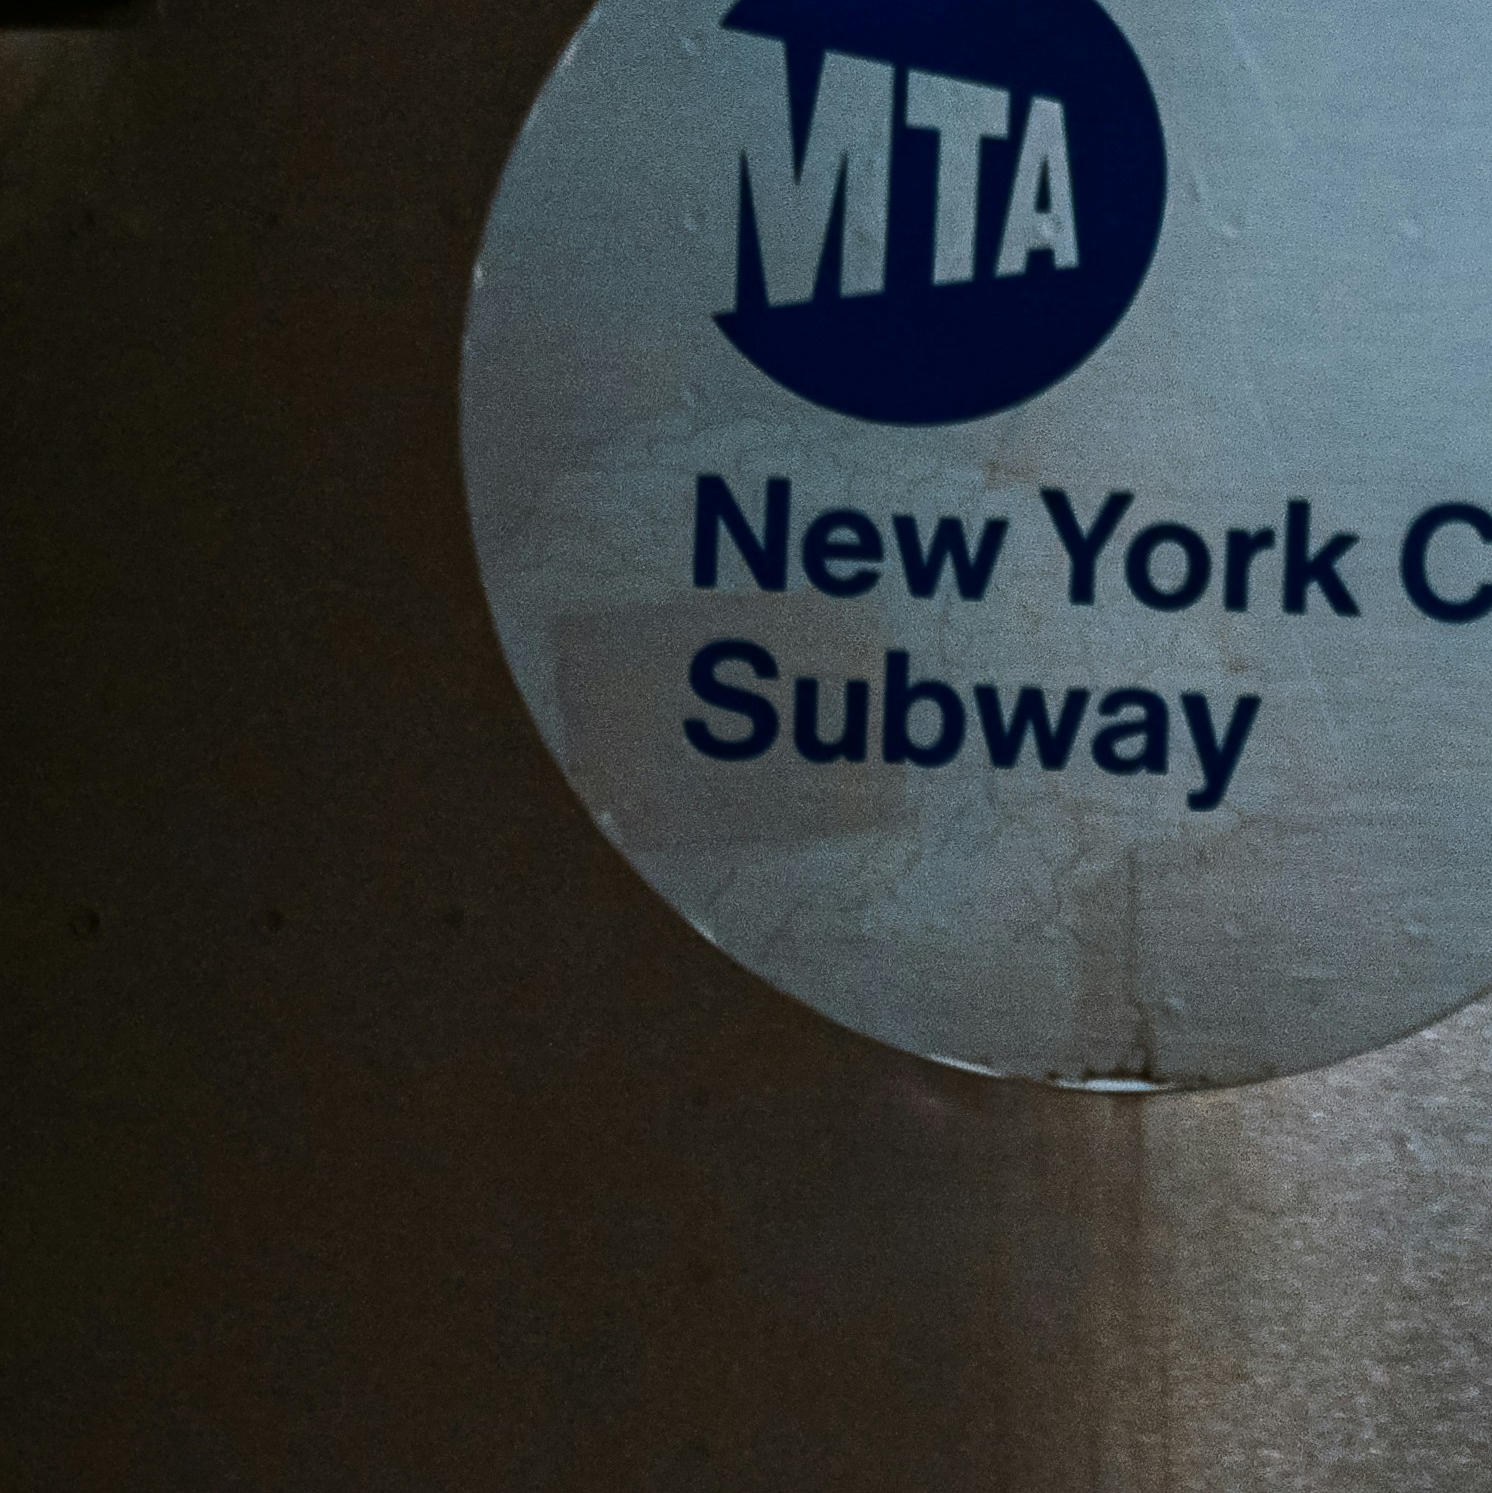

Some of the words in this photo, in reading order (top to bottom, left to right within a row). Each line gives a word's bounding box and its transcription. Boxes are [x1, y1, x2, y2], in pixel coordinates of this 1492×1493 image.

[718, 22, 1082, 314] MTA
[689, 469, 1012, 604] New
[1037, 485, 1362, 620] York
[678, 634, 1264, 815] Subway
